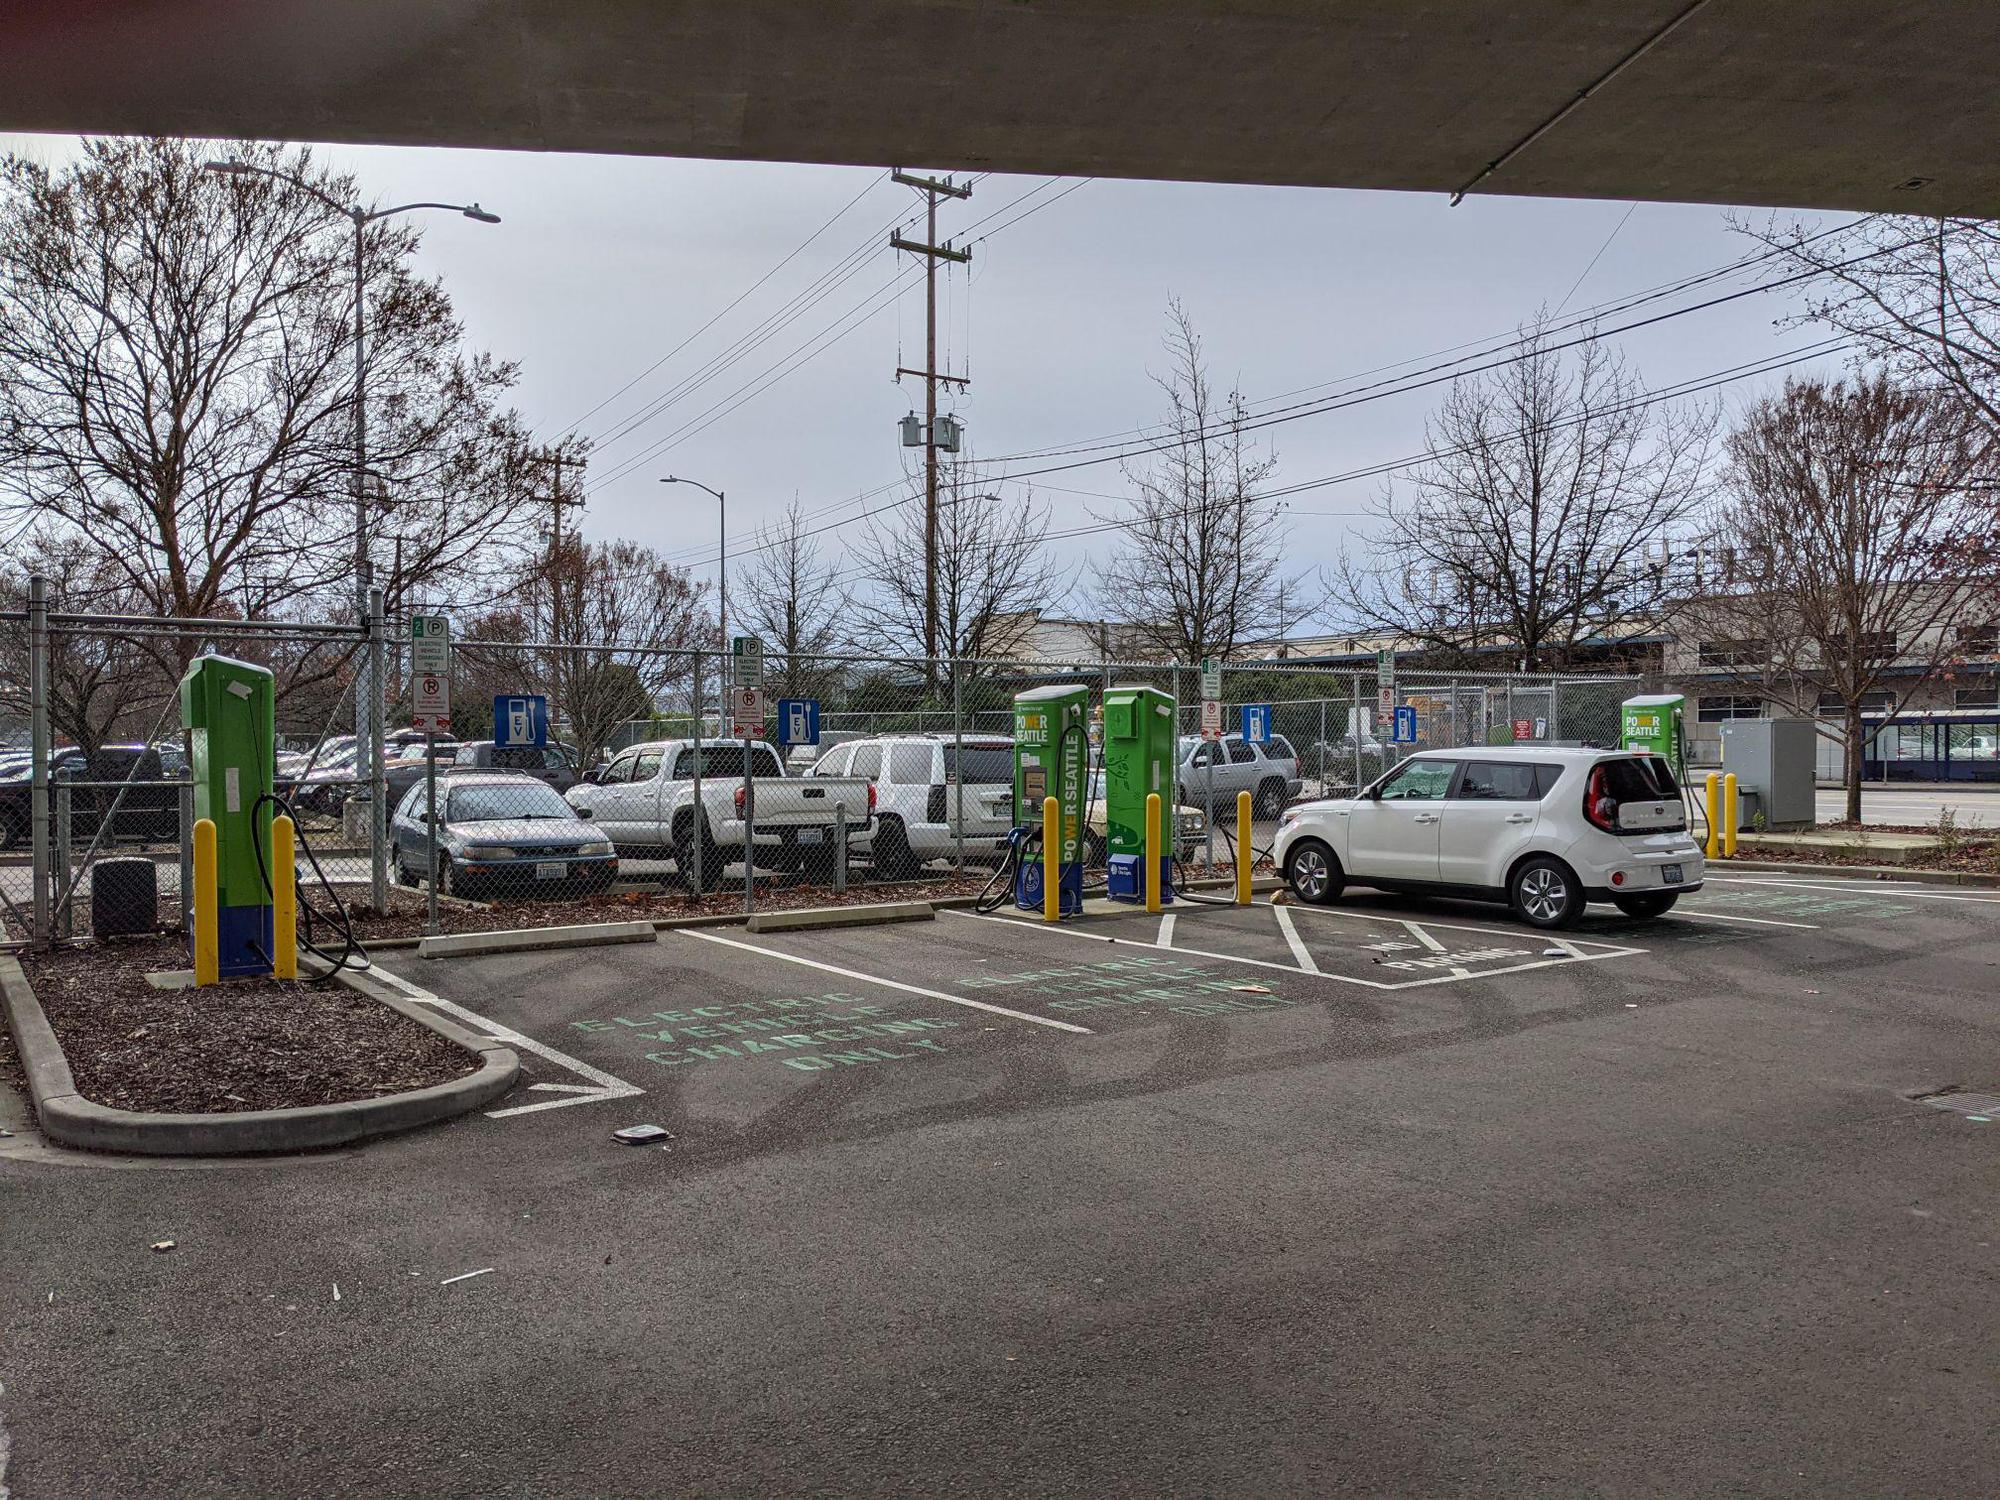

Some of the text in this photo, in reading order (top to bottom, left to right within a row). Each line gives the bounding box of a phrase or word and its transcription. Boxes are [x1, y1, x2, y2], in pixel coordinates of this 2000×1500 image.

[514, 715, 522, 736] EV
[794, 717, 801, 736] EV
[1016, 715, 1048, 729] POWER
[1252, 719, 1258, 735] EV
[1626, 727, 1660, 736] SEATTLE
[1016, 730, 1048, 742] SEATTLE
[1064, 735, 1078, 861] POWER SEATTLE
[569, 992, 866, 1033] ELECTRIC
[634, 1005, 898, 1043] VEHICLE
[644, 1017, 960, 1065] CHARGING
[780, 1039, 949, 1071] ONLY
